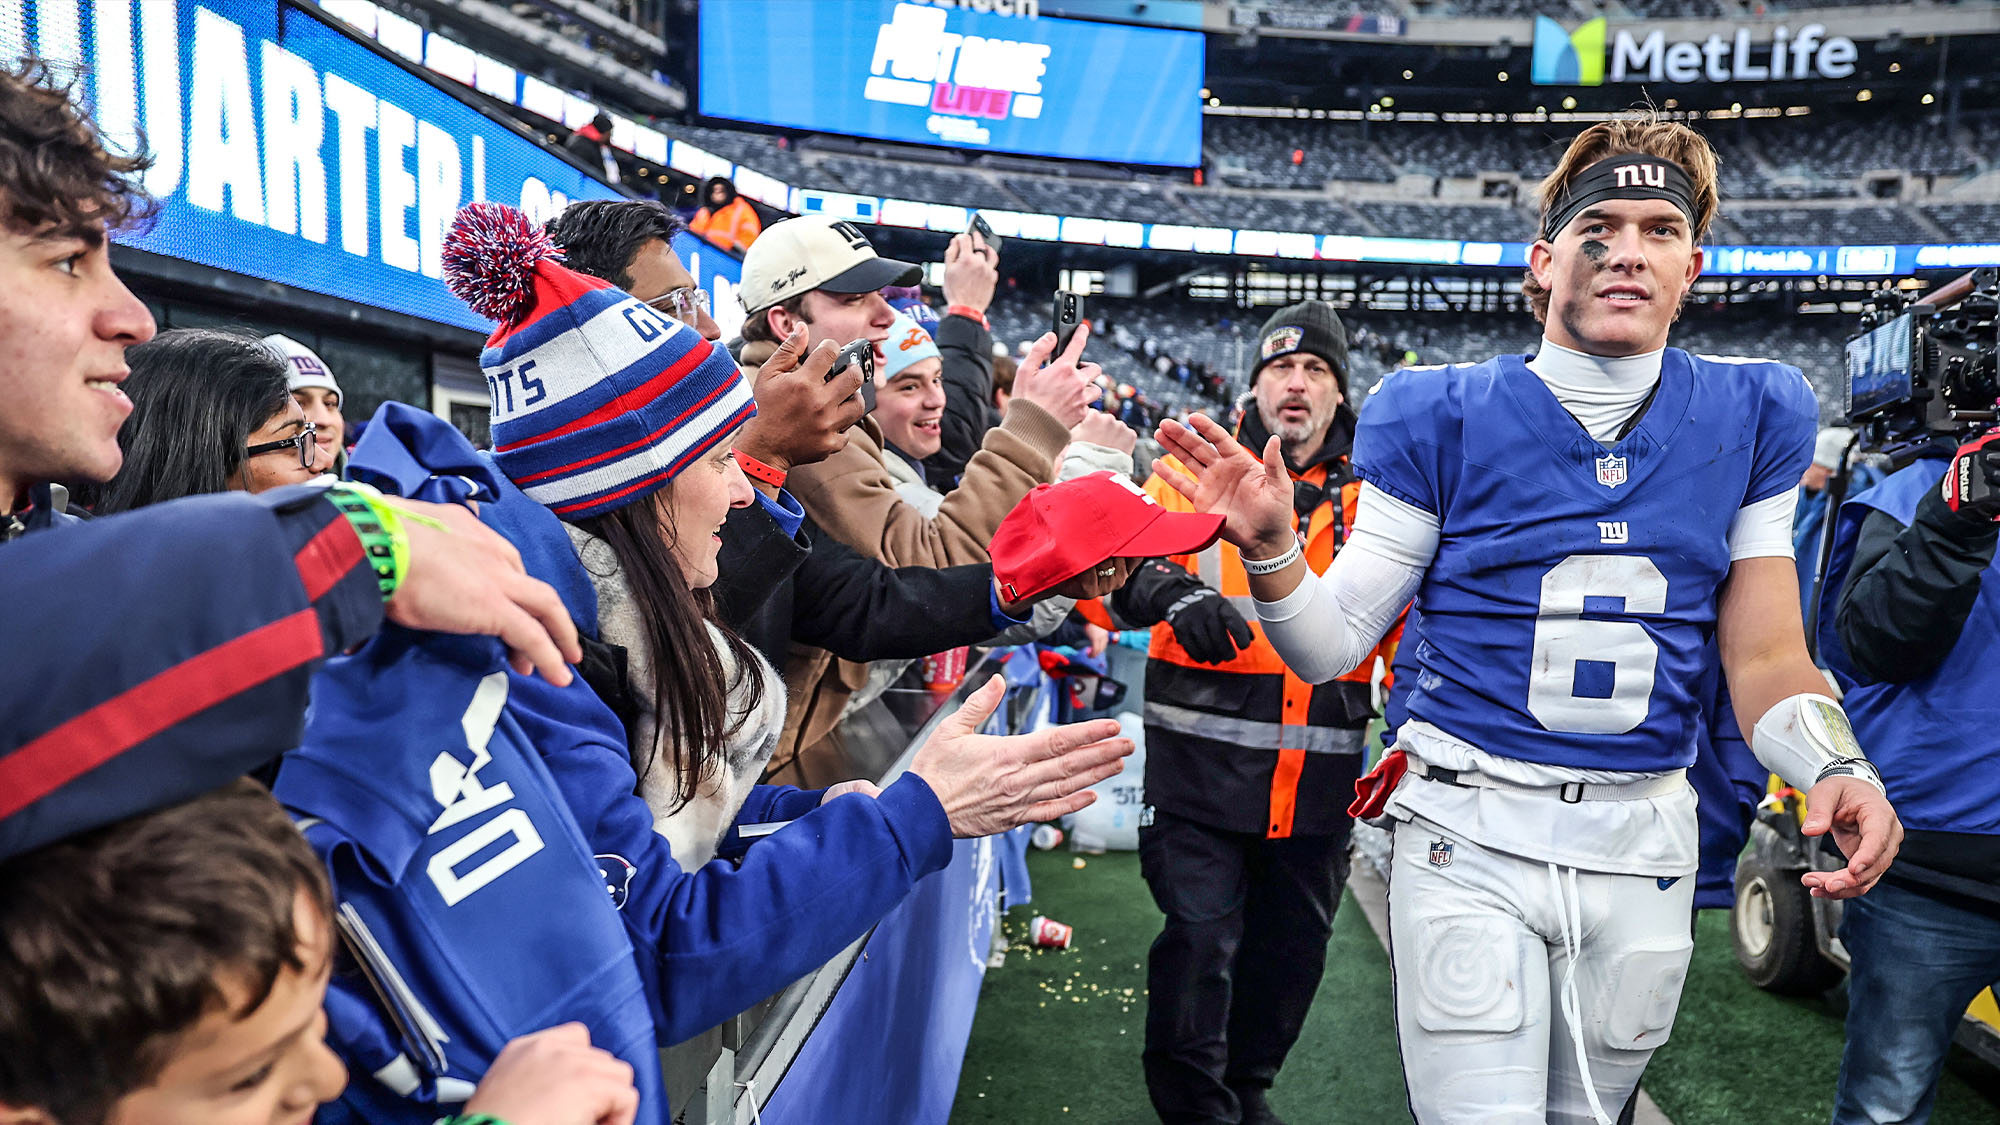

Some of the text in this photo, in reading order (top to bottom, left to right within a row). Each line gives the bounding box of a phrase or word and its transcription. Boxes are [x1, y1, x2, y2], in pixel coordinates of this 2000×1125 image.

[1610, 24, 1858, 83] MetLife
[932, 83, 1011, 119] LIVE
[788, 265, 808, 287] York
[1602, 469, 1622, 482] NFL
[1959, 456, 1970, 503] ASTARS
[1528, 554, 1668, 735] 6
[1431, 851, 1448, 864] NFL
